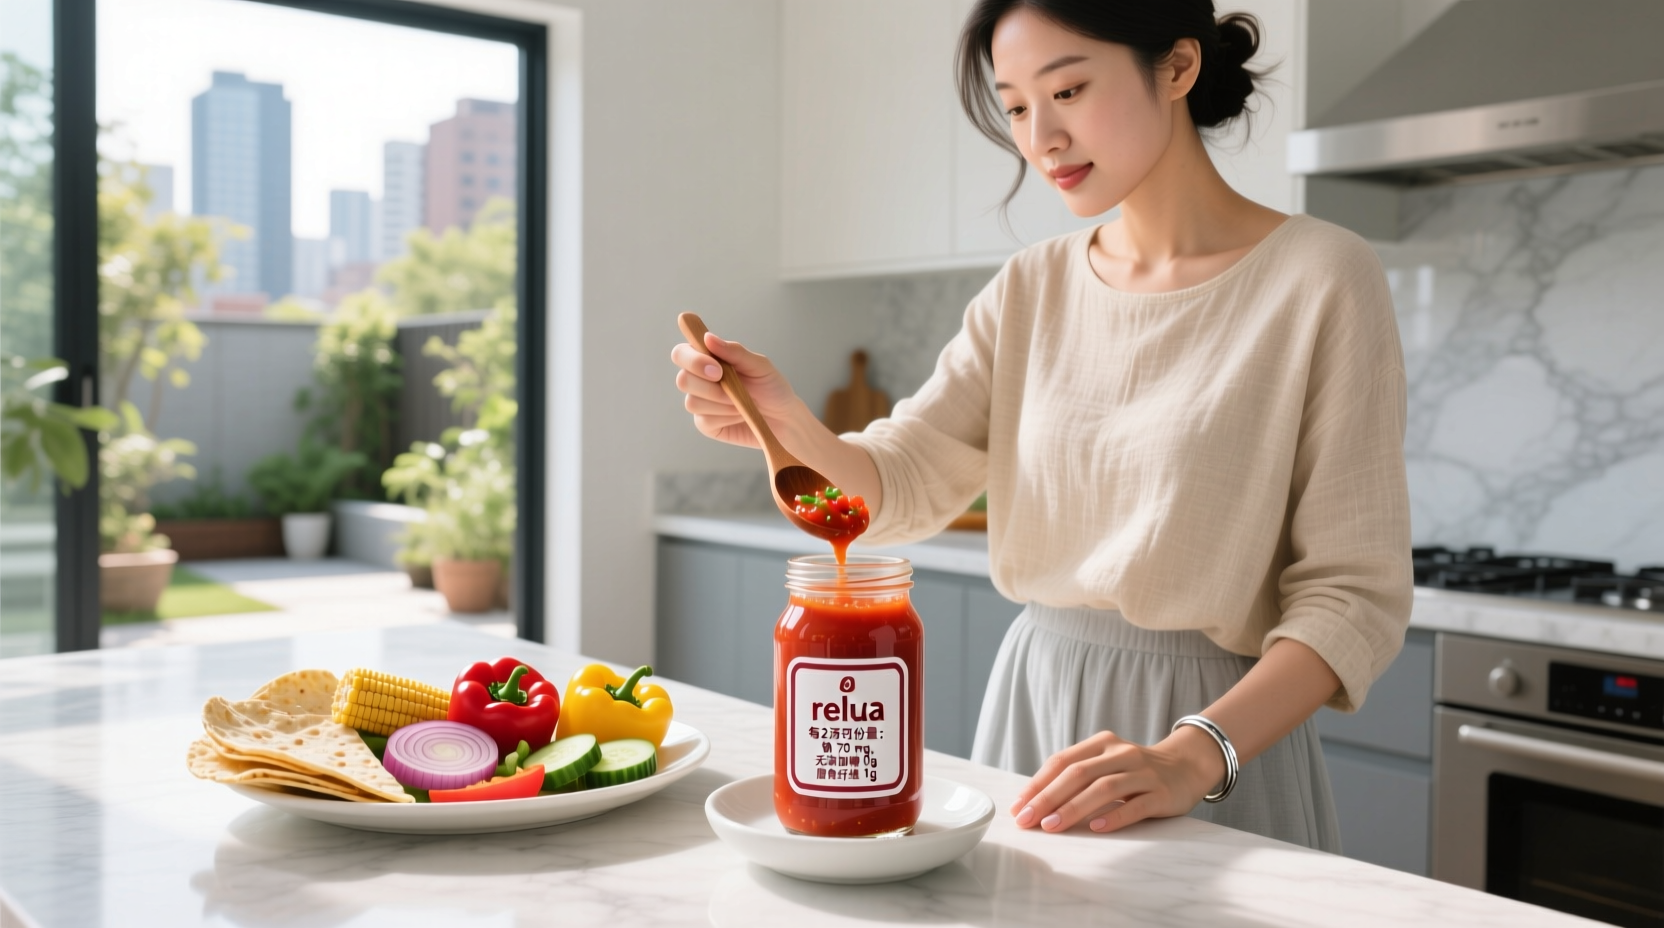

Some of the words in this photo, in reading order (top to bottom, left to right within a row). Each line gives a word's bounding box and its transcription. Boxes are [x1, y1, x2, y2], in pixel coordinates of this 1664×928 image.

[812, 695, 884, 721] relua
[836, 743, 850, 753] 70
[864, 768, 877, 782] 1g
